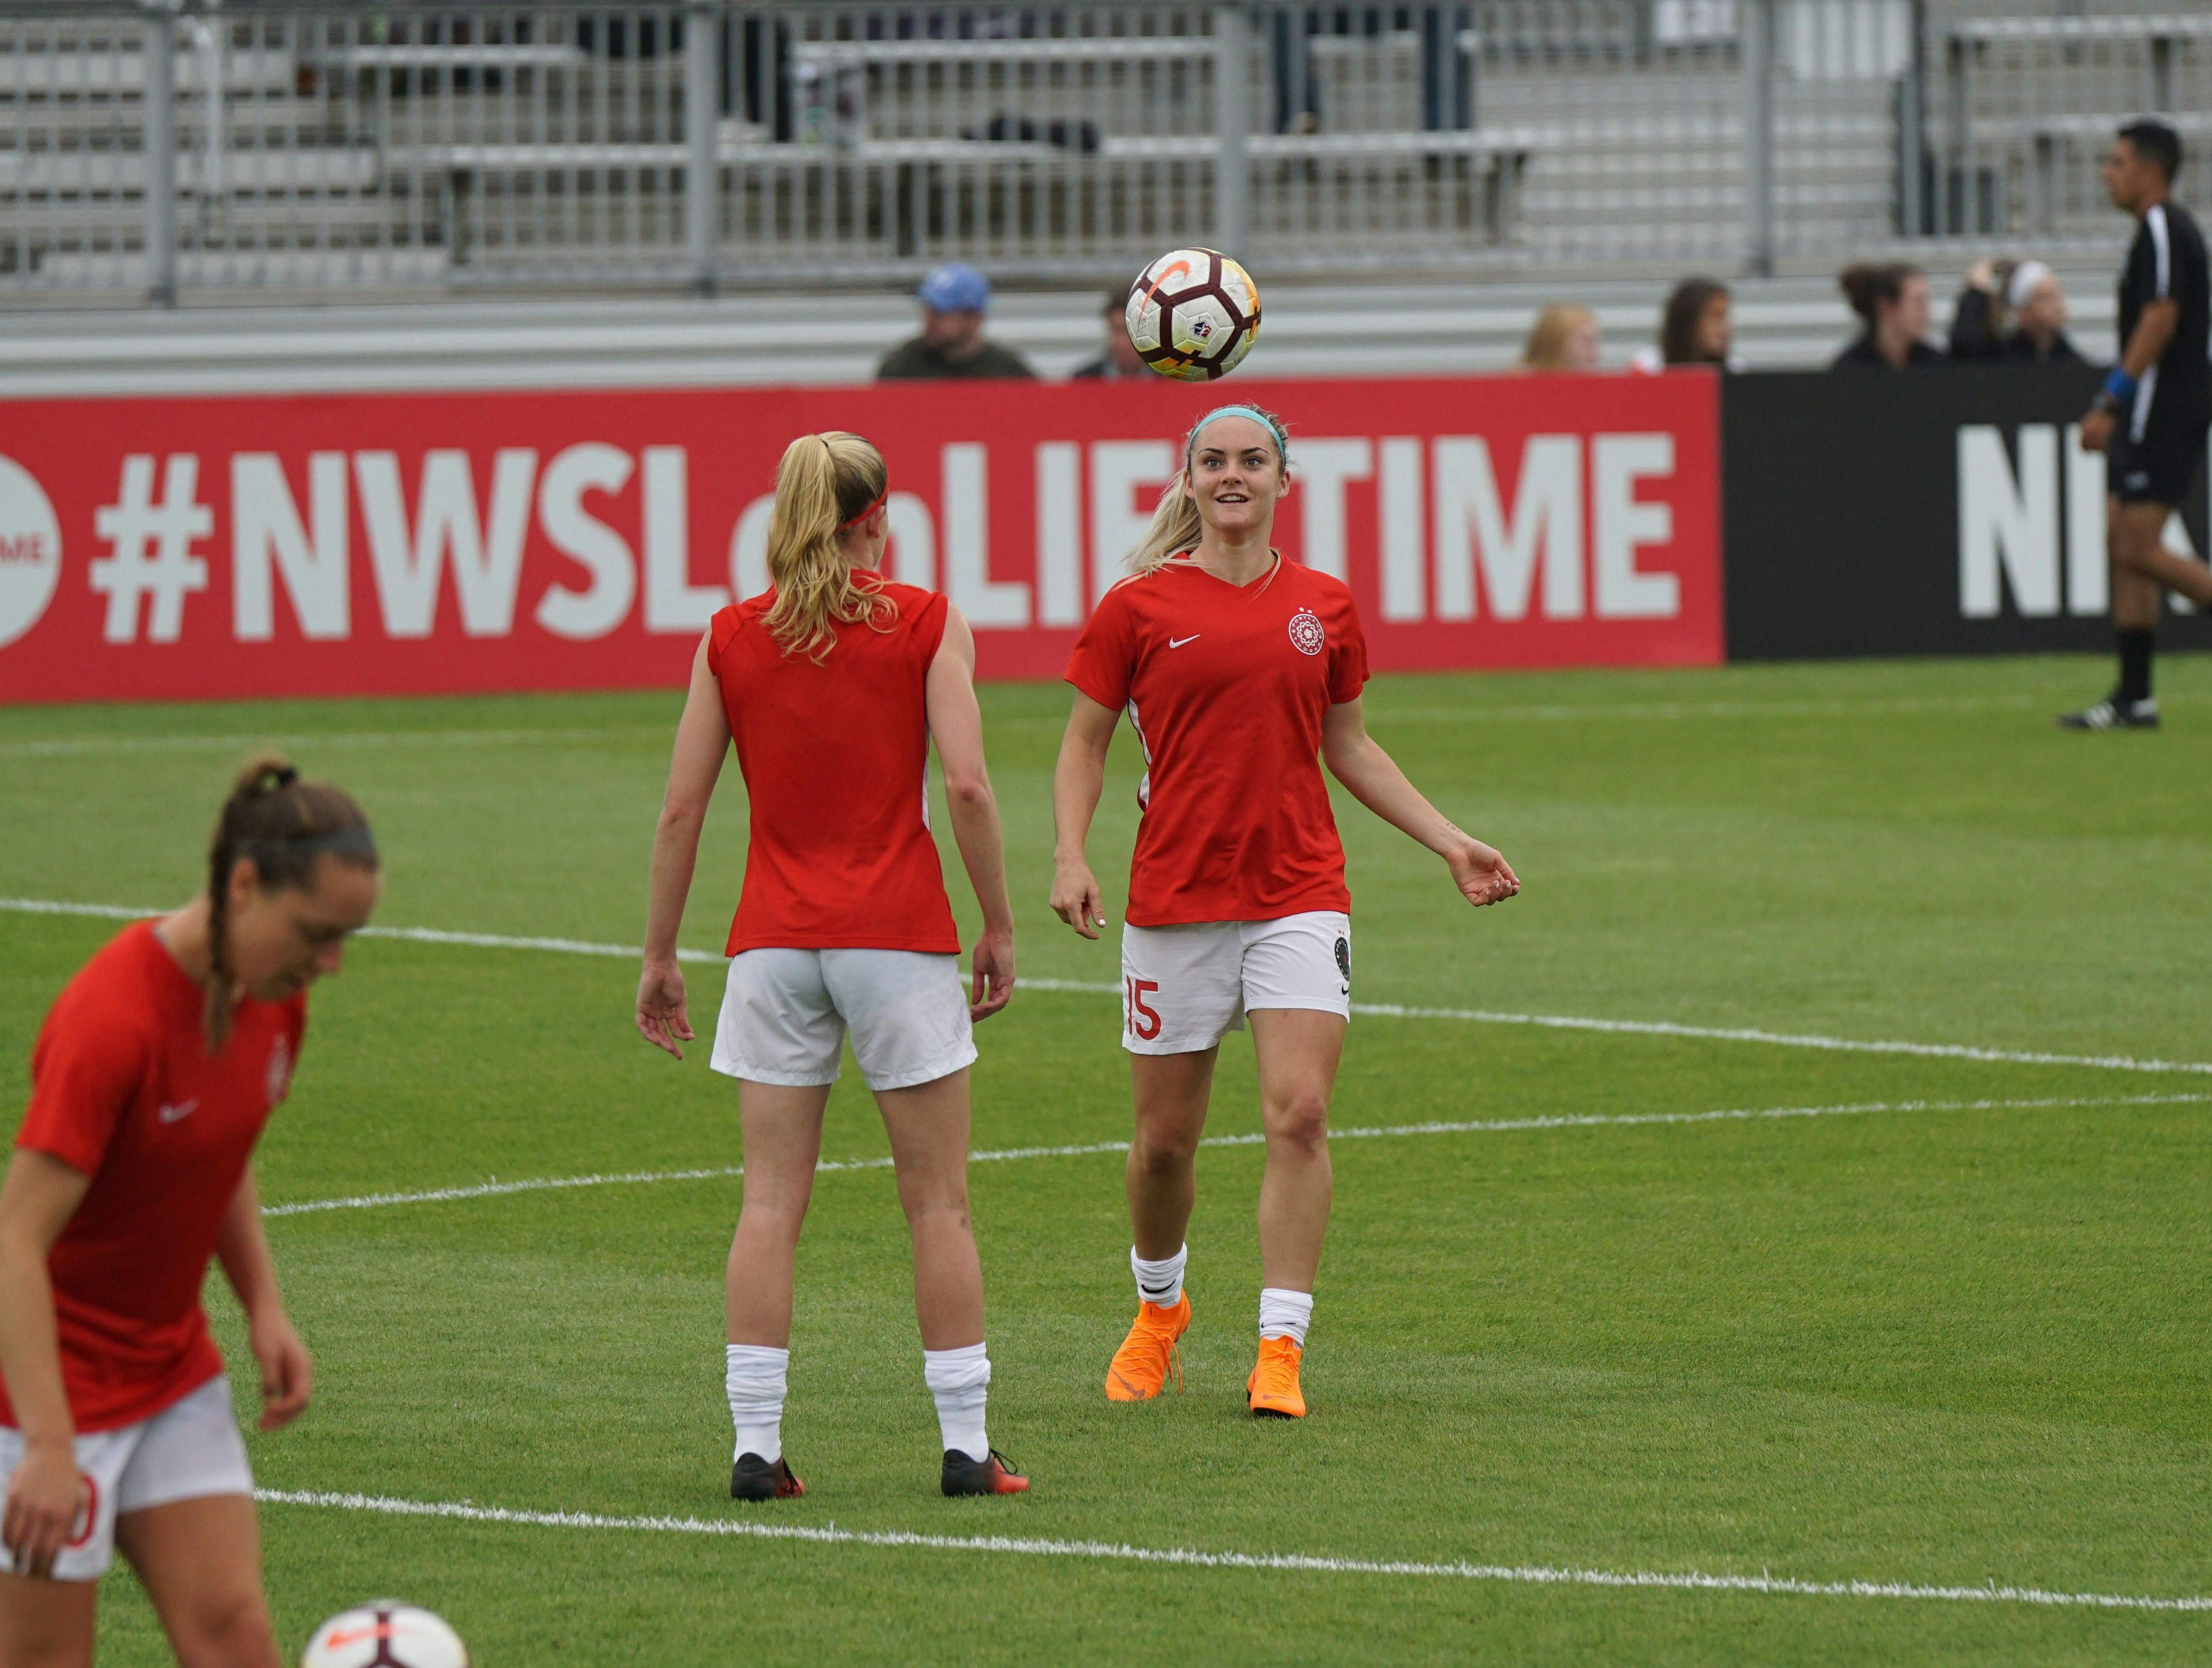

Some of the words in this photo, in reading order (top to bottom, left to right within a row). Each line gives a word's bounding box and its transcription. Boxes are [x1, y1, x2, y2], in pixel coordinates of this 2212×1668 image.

[89, 432, 1680, 643] #NWSLLIFTIME
[1957, 422, 2212, 618] NI
[1126, 974, 1162, 1041] 15
